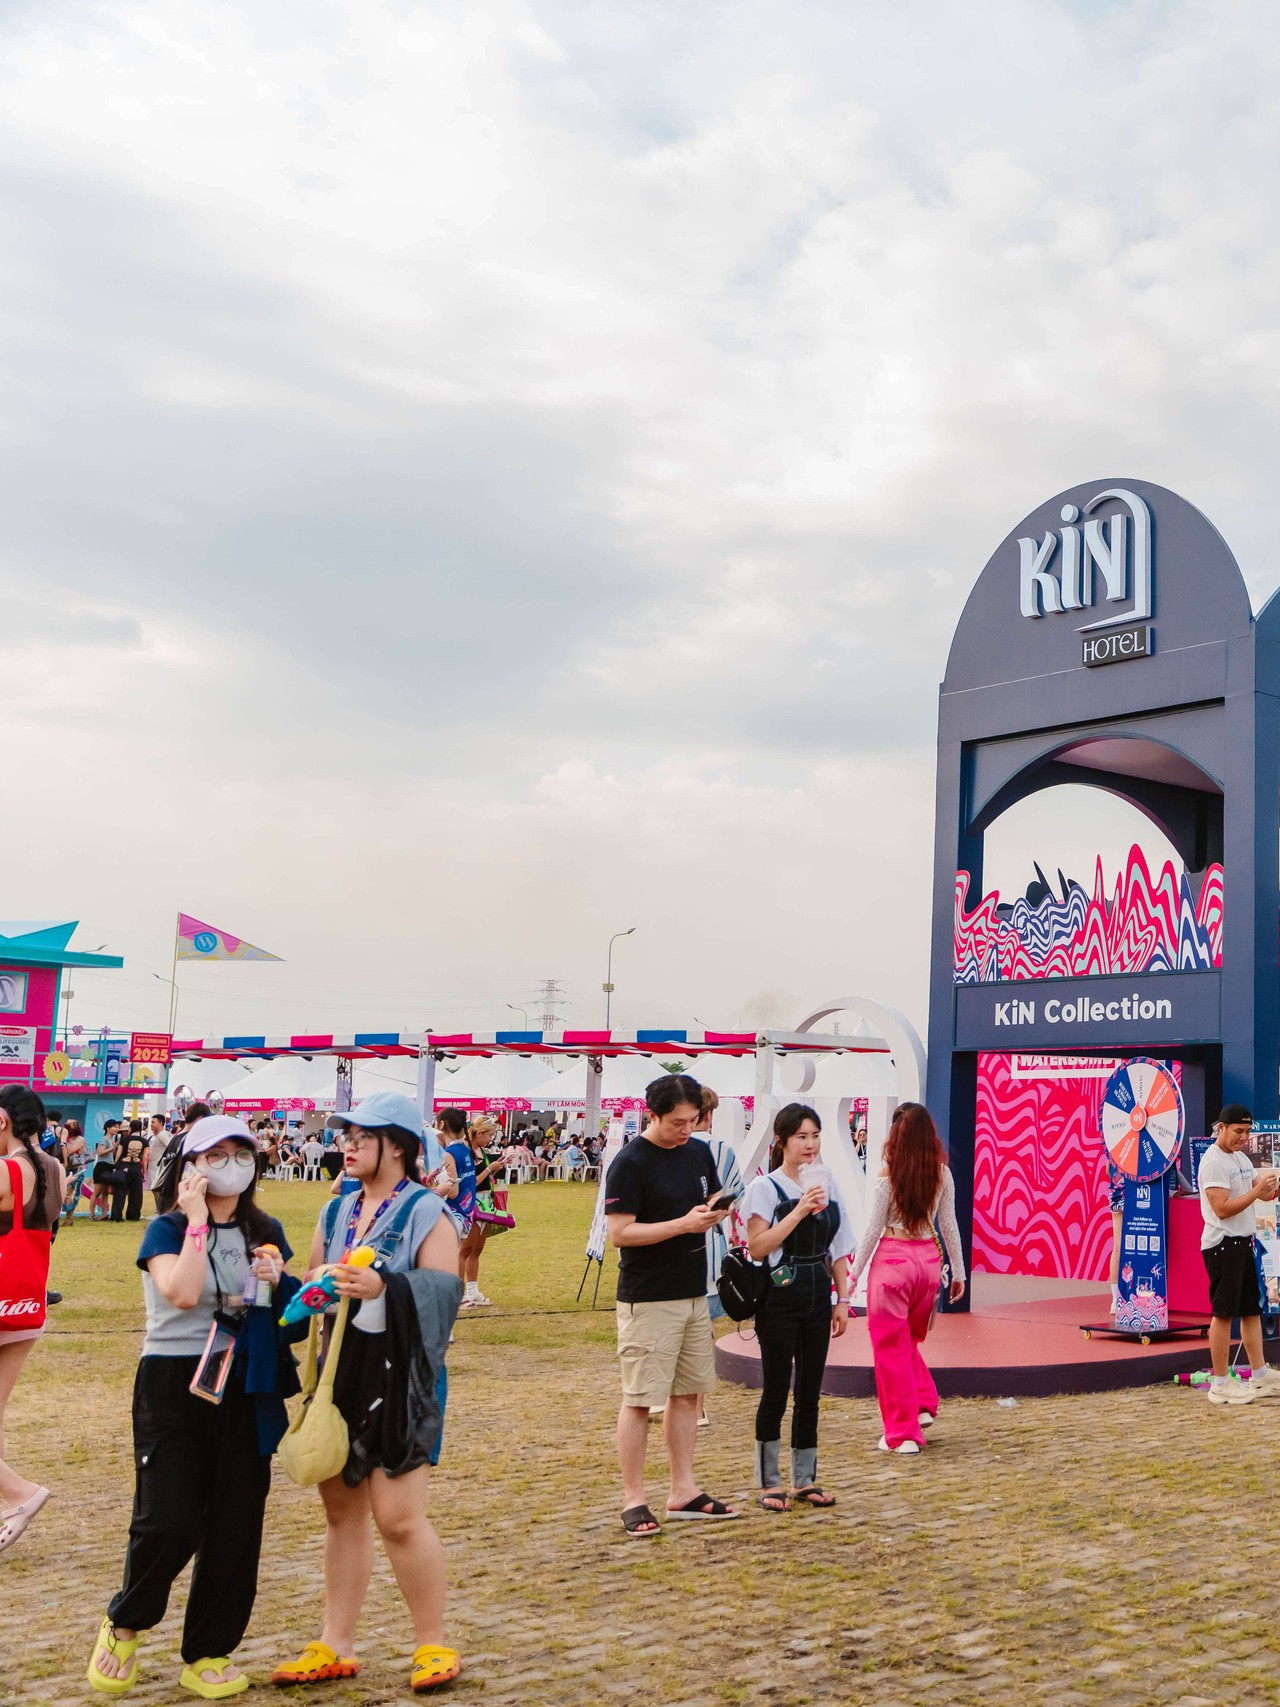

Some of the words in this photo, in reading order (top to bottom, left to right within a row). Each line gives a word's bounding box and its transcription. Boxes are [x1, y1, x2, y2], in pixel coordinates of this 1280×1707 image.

[1083, 631, 1145, 662] HOTEL
[995, 999, 1035, 1026] KiN
[1044, 993, 1172, 1023] Collection
[133, 1048, 169, 1062] 2025
